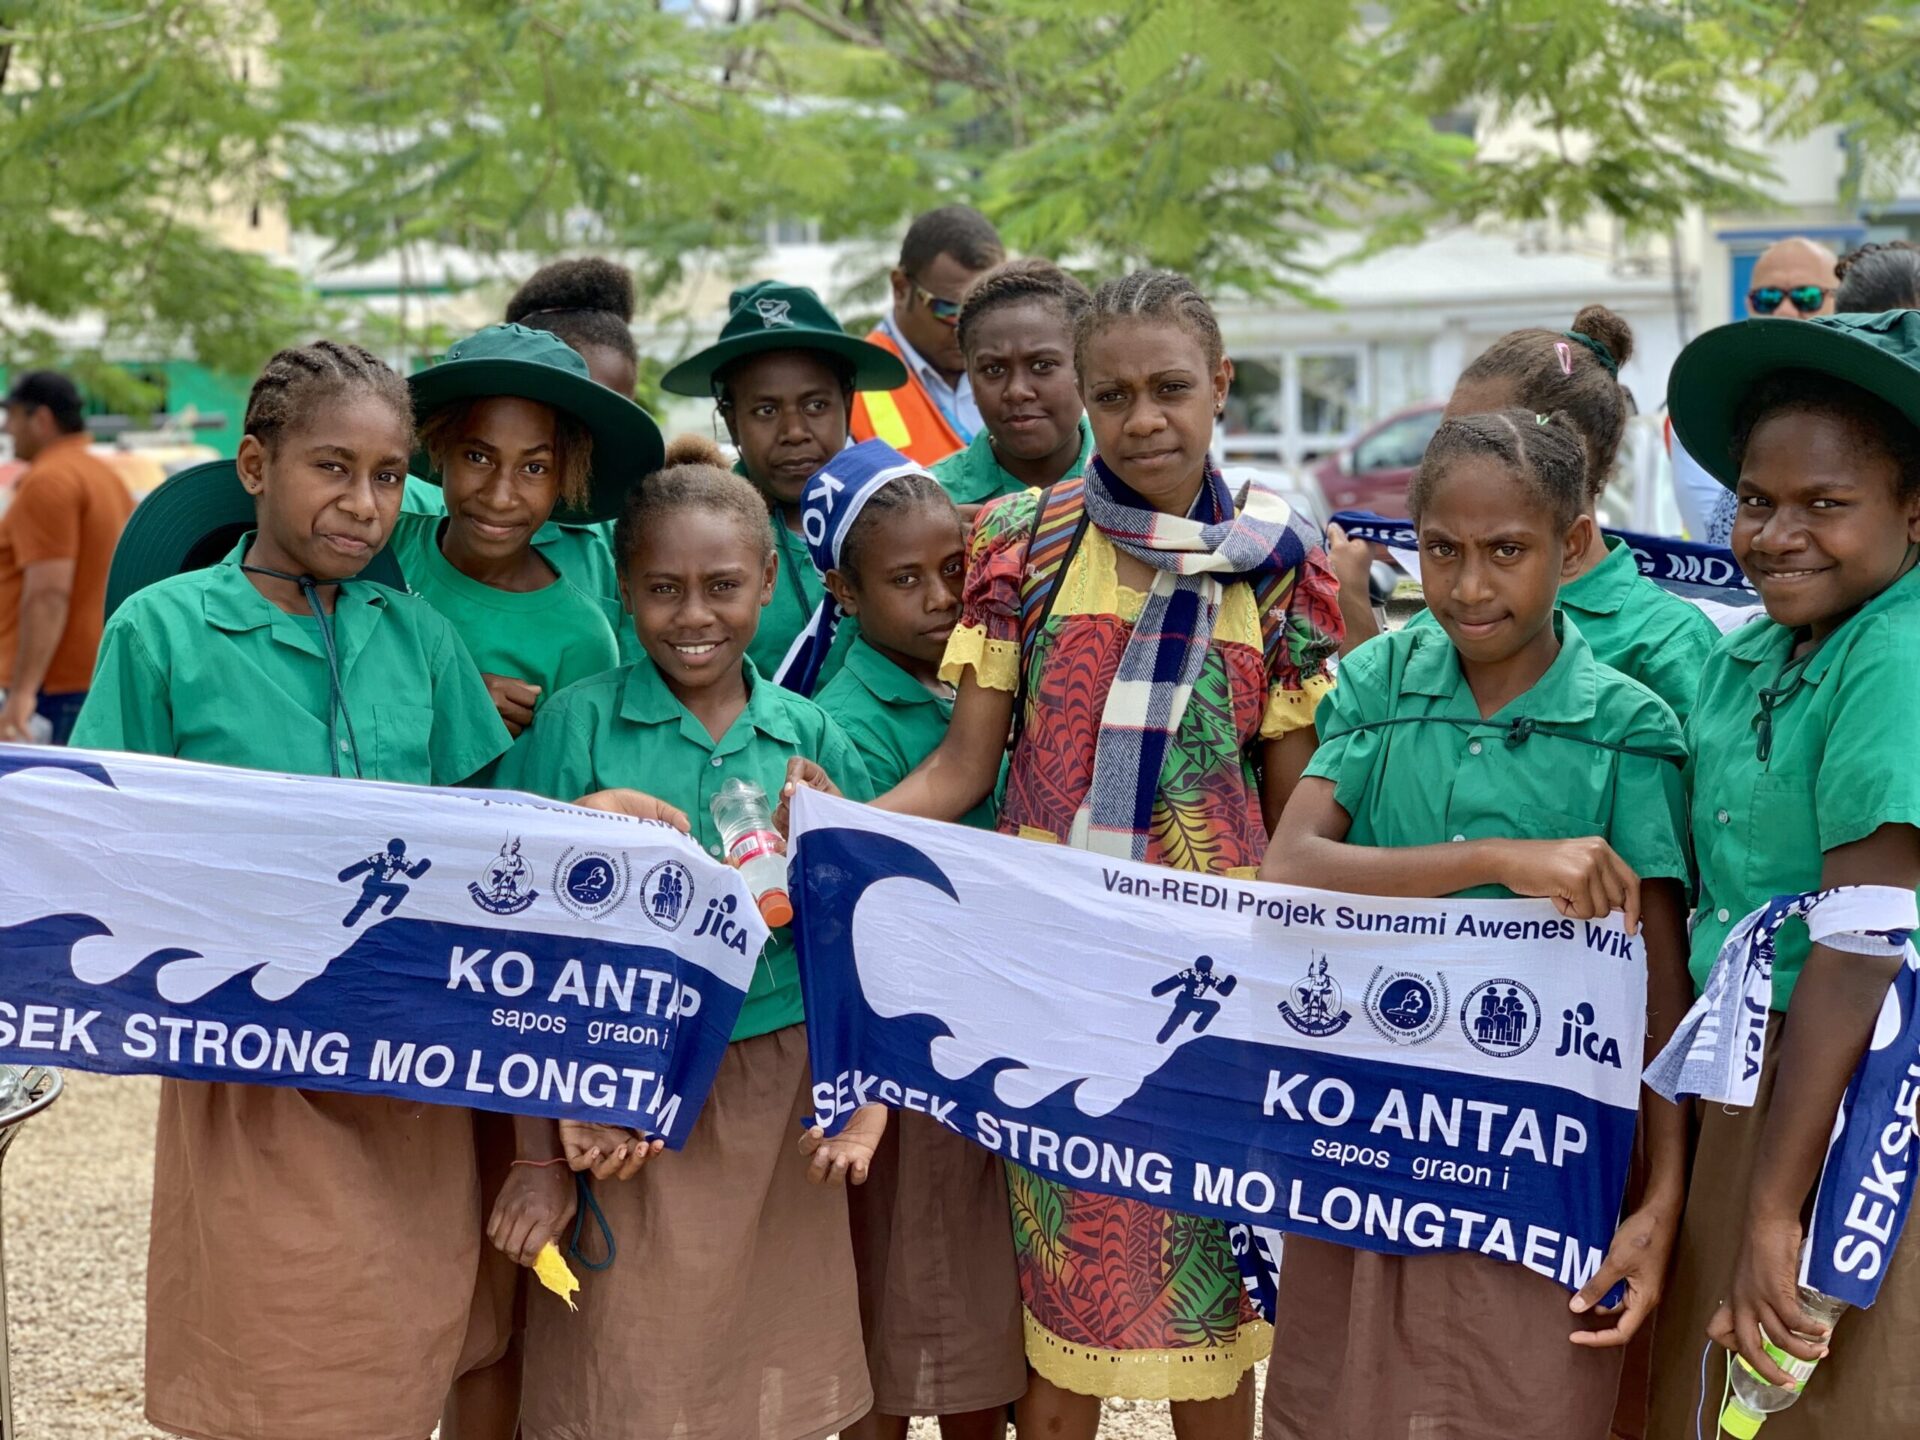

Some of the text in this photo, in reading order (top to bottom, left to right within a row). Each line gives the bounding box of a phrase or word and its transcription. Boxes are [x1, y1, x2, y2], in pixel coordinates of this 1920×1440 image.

[803, 472, 845, 546] KO
[1103, 868, 1633, 961] Van-REDI Projek Sunami Awenes Wik
[447, 947, 534, 996] KO
[122, 1013, 349, 1075] STRONG
[369, 1040, 454, 1087] MO
[492, 1009, 566, 1034] sapos
[588, 1021, 658, 1046] graon
[1264, 1070, 1587, 1166] KO ANTAP
[813, 1071, 961, 1132] SEKSEK
[976, 1112, 1172, 1194] STRONG
[1194, 1163, 1275, 1213] MO
[1289, 1180, 1602, 1292] LONGTAEM
[1312, 1139, 1509, 1191] sapos graon i
